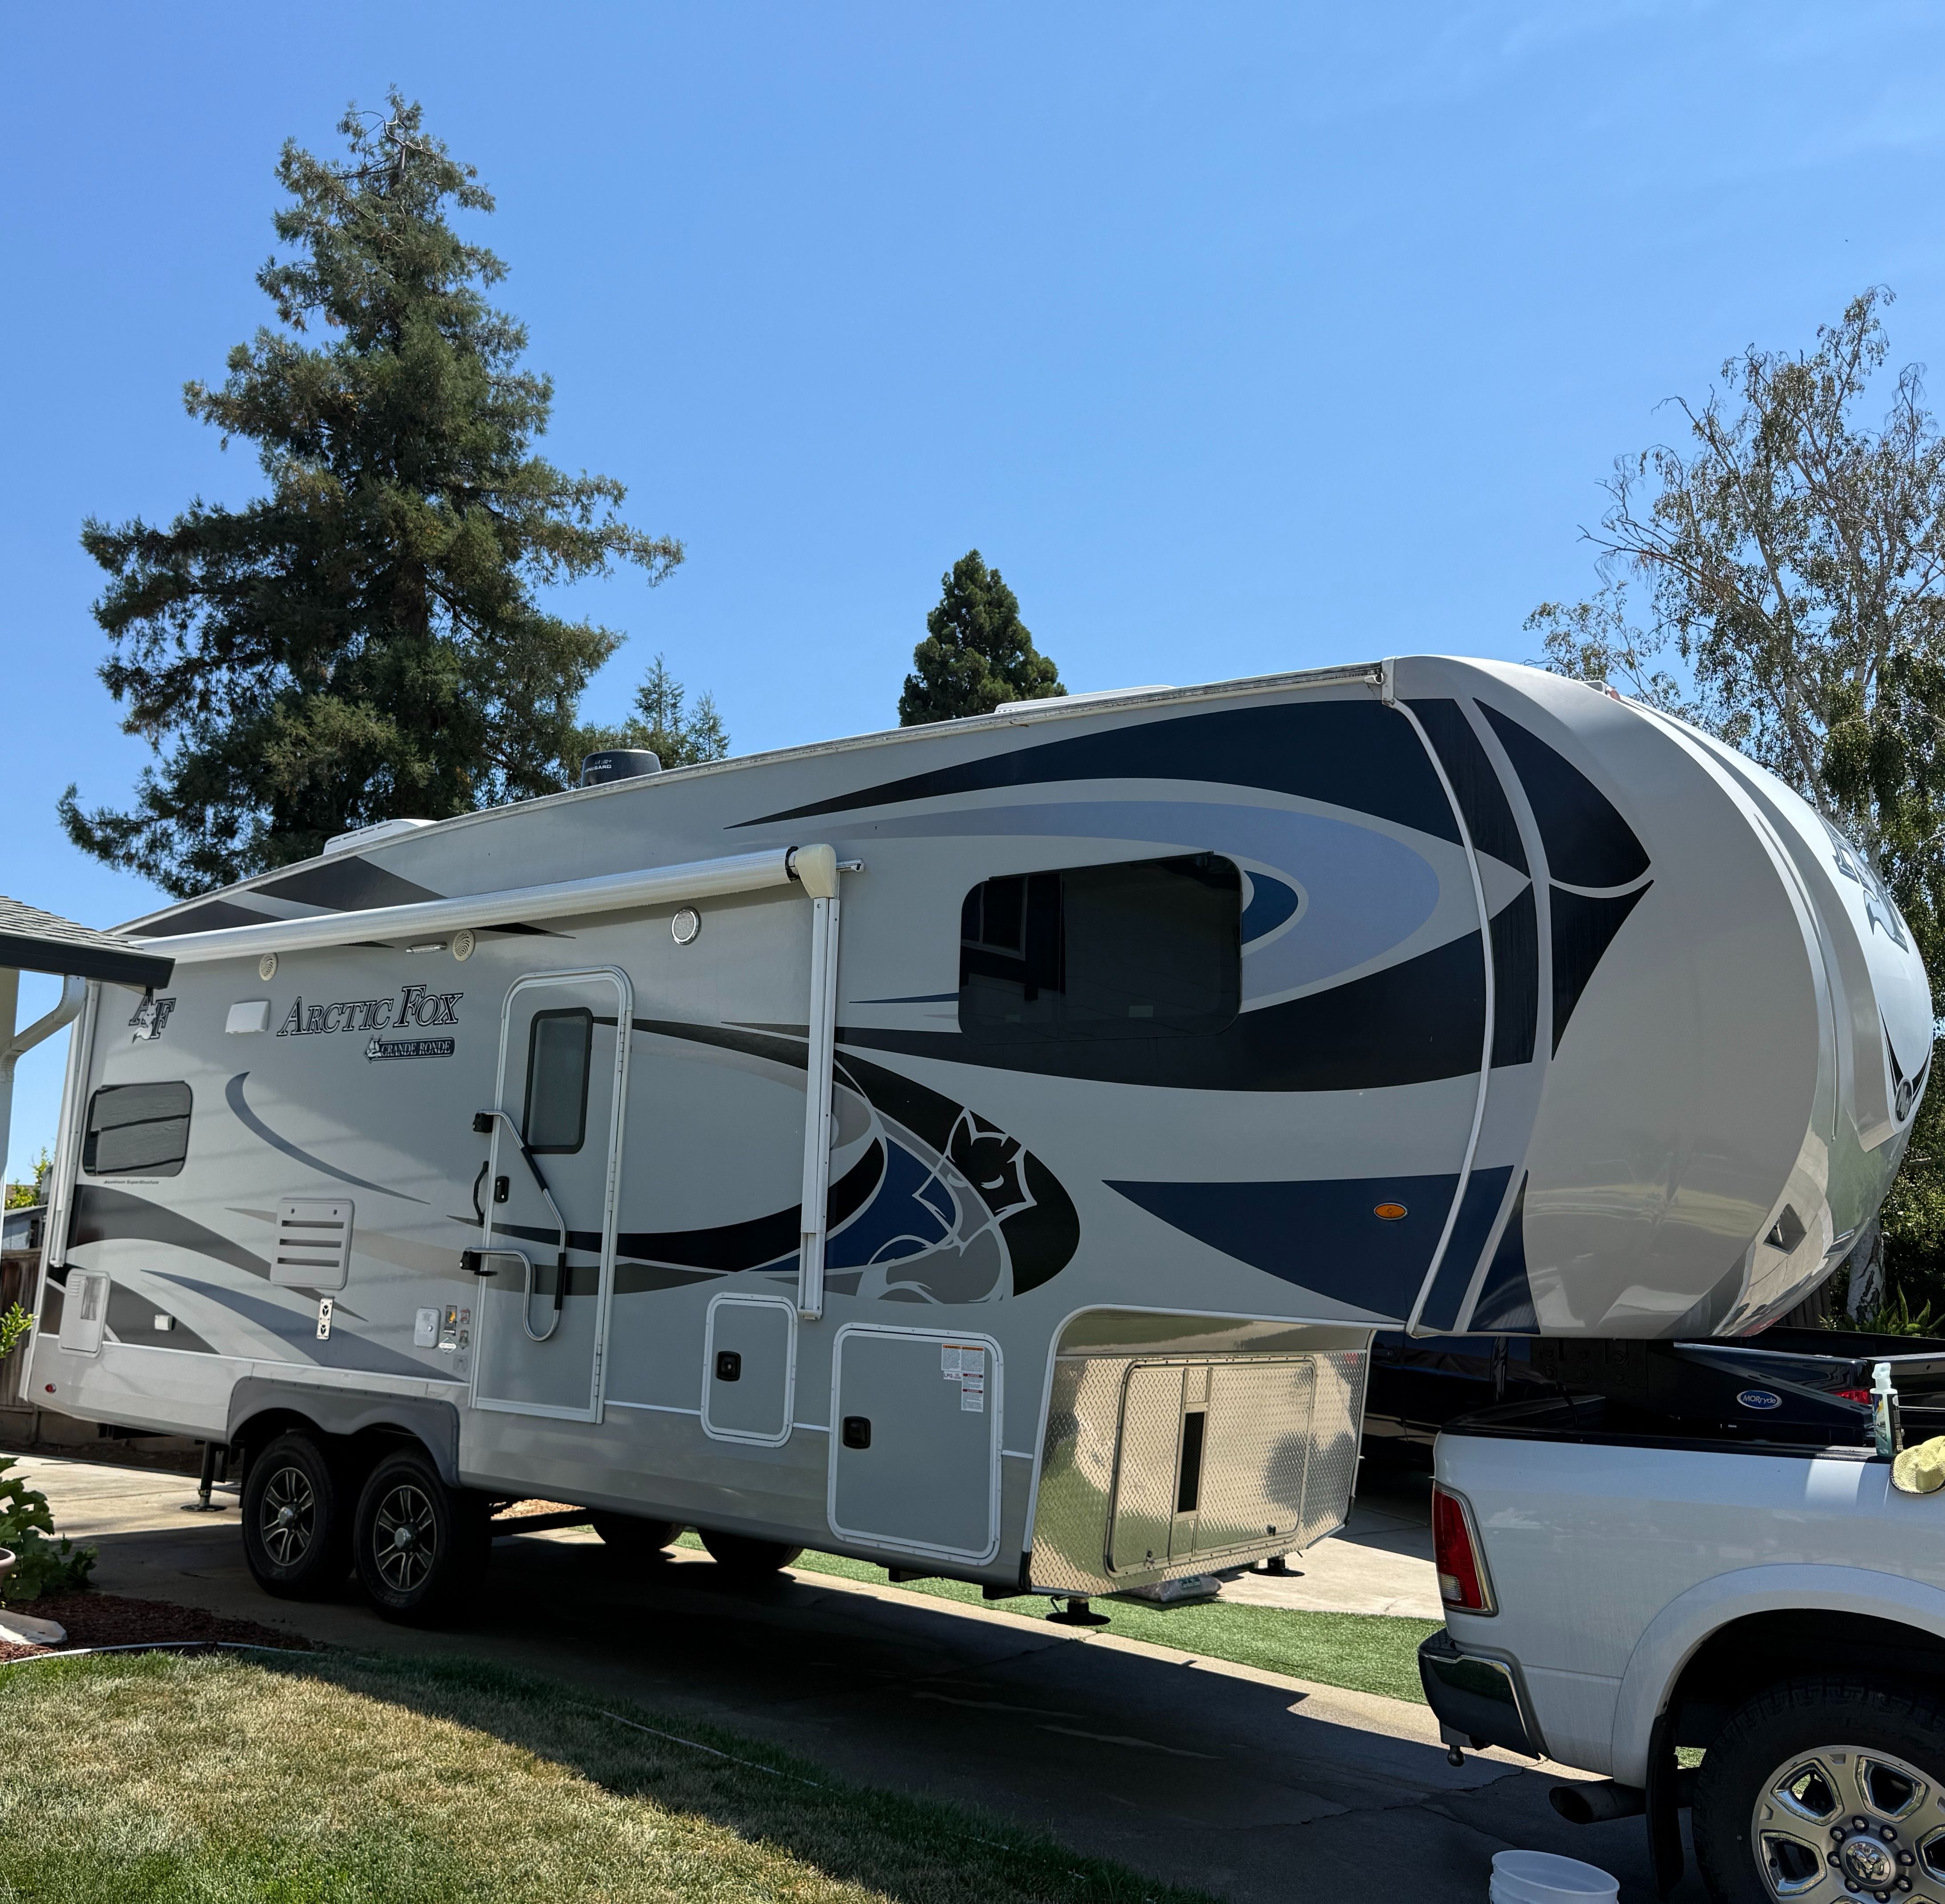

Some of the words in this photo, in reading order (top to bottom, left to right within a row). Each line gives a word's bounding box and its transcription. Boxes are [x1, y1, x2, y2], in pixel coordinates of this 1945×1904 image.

[276, 996, 394, 1036] ARCTIC
[392, 984, 464, 1028] FOX
[381, 1043, 416, 1057] GRANDE
[419, 1041, 451, 1055] RONDE
[1743, 1395, 1777, 1404] MORryde
